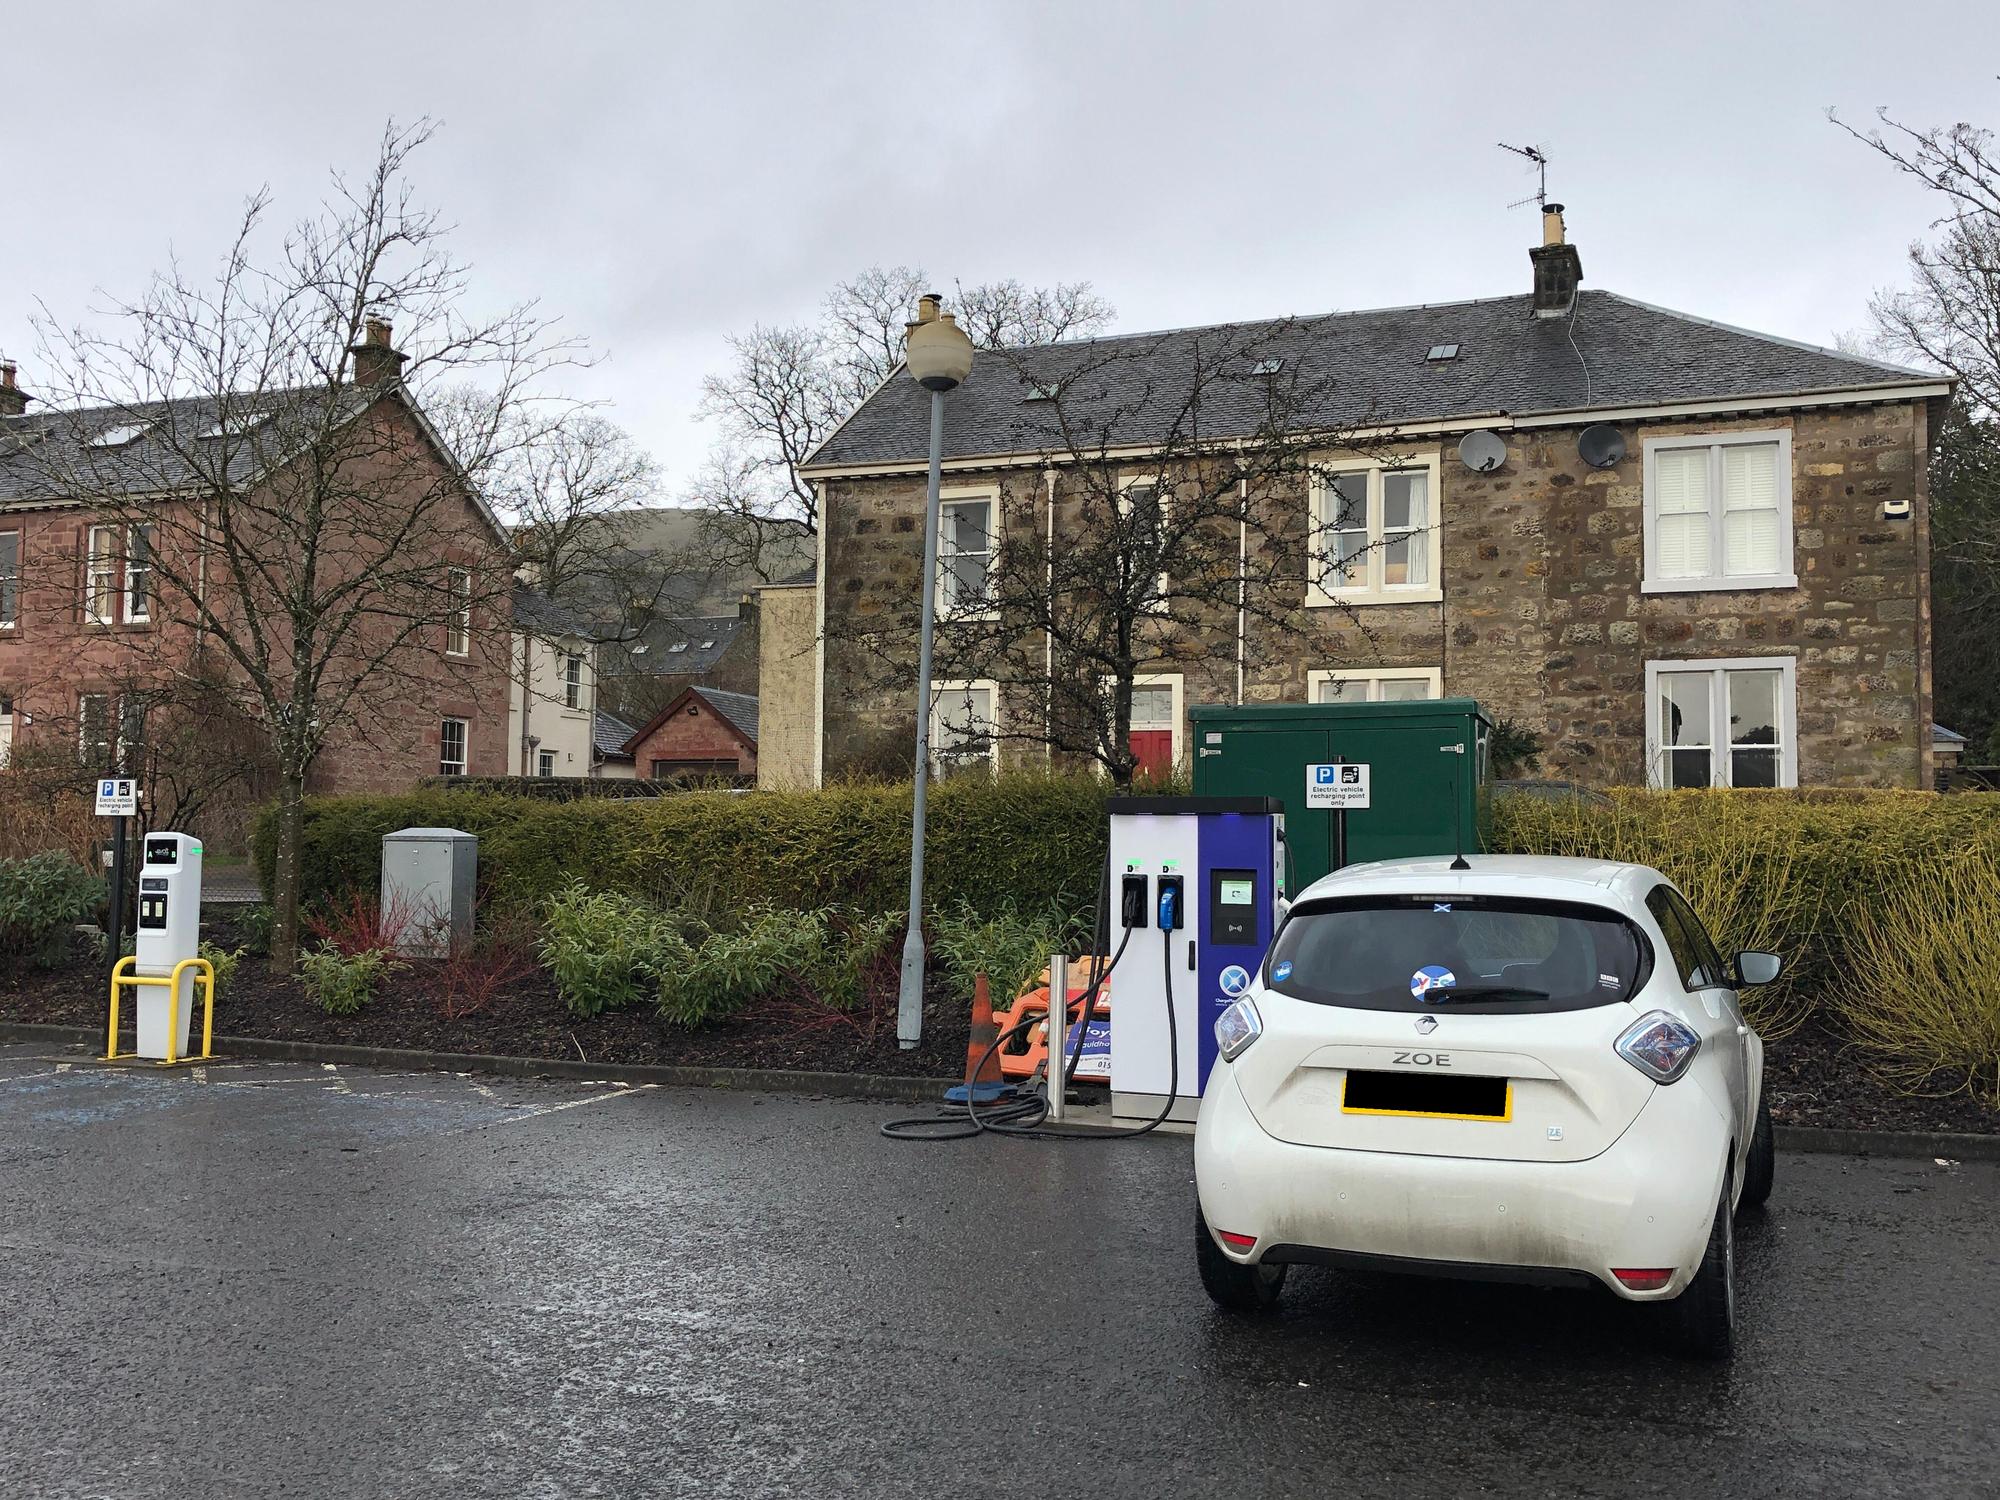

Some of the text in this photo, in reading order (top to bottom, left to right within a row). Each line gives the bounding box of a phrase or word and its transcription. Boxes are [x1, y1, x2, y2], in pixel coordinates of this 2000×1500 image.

[1320, 768, 1330, 782] P
[104, 783, 112, 795] P
[1392, 1052, 1451, 1066] ZOE
